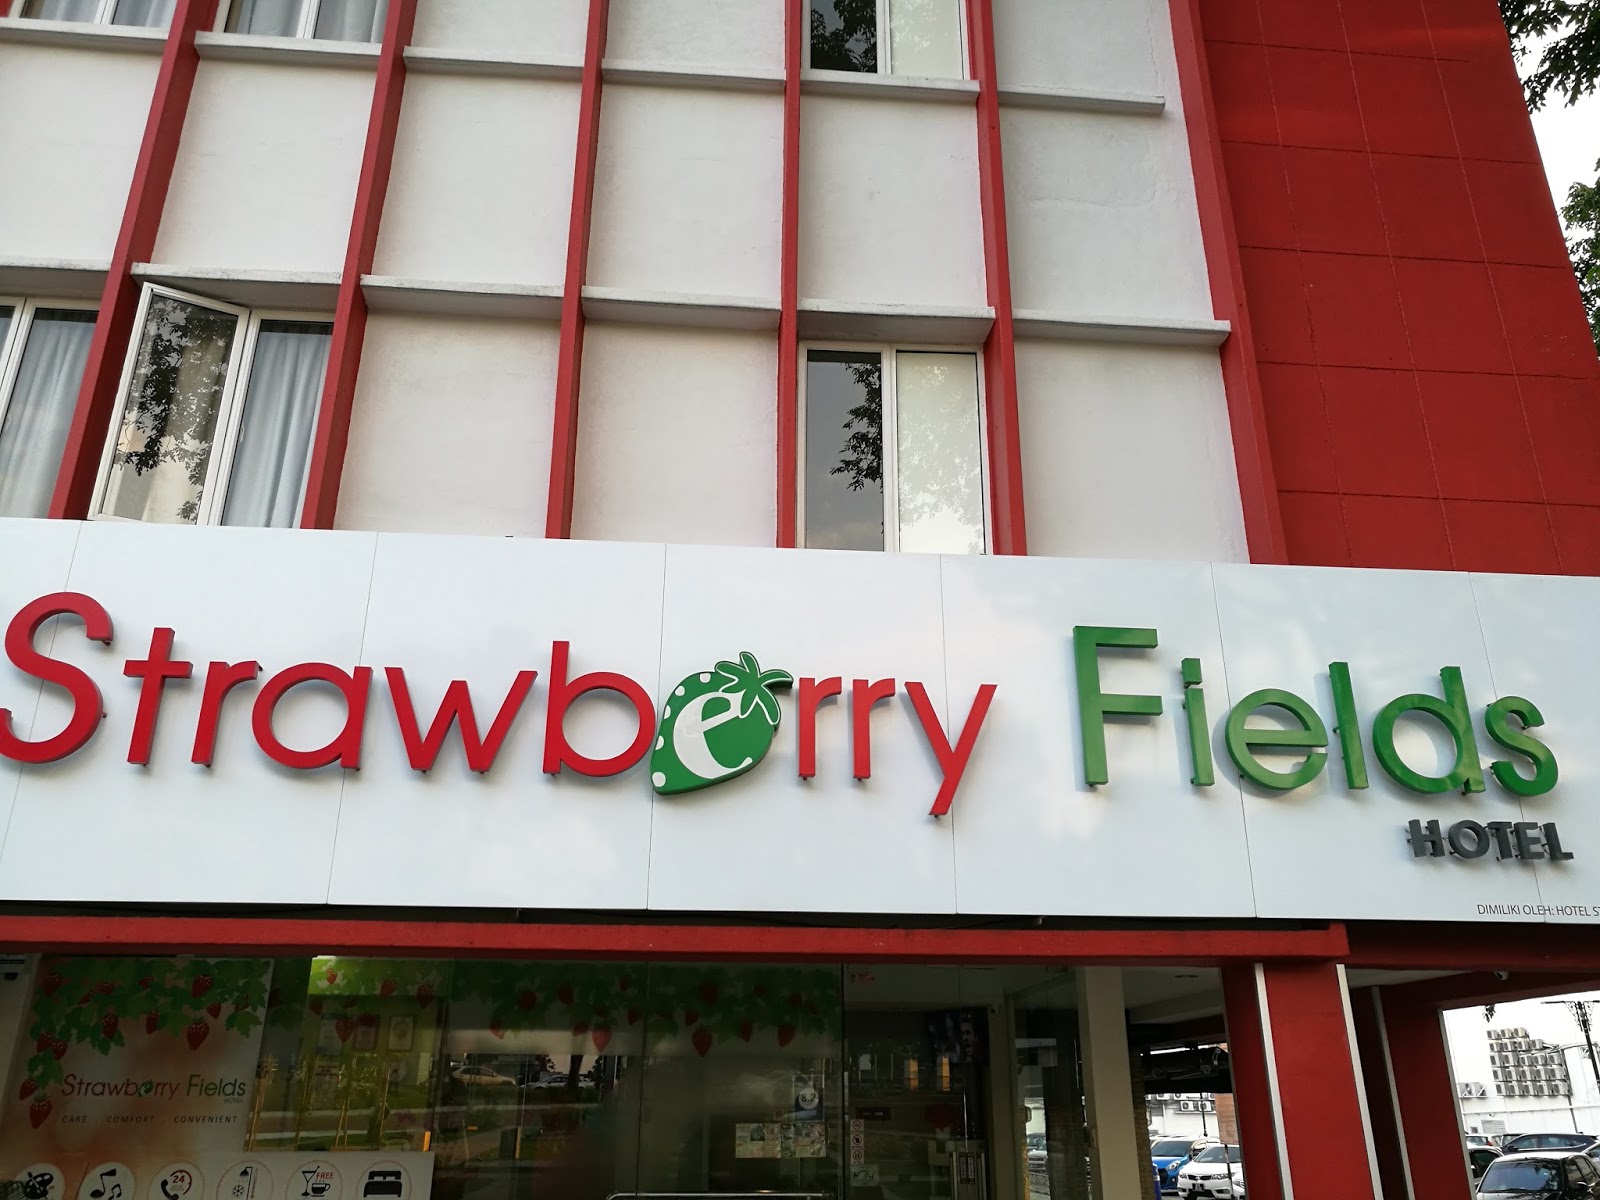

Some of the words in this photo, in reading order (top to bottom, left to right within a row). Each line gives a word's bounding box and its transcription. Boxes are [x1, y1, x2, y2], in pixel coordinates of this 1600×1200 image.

[0, 592, 998, 816] Strawberry
[1073, 625, 1559, 797] Fields
[1408, 819, 1574, 861] HOTEL
[1477, 904, 1521, 915] DIMILIKI
[1522, 904, 1555, 916] OLEH:
[1556, 905, 1591, 917] HOTEL
[61, 1073, 180, 1100] Strawberry
[186, 1074, 246, 1097] Fields
[62, 1115, 87, 1124] CARE
[106, 1115, 155, 1124] COMFORT
[174, 1115, 238, 1124] CONVENIENT
[172, 1175, 185, 1183] 24
[316, 1172, 334, 1180] FREE
